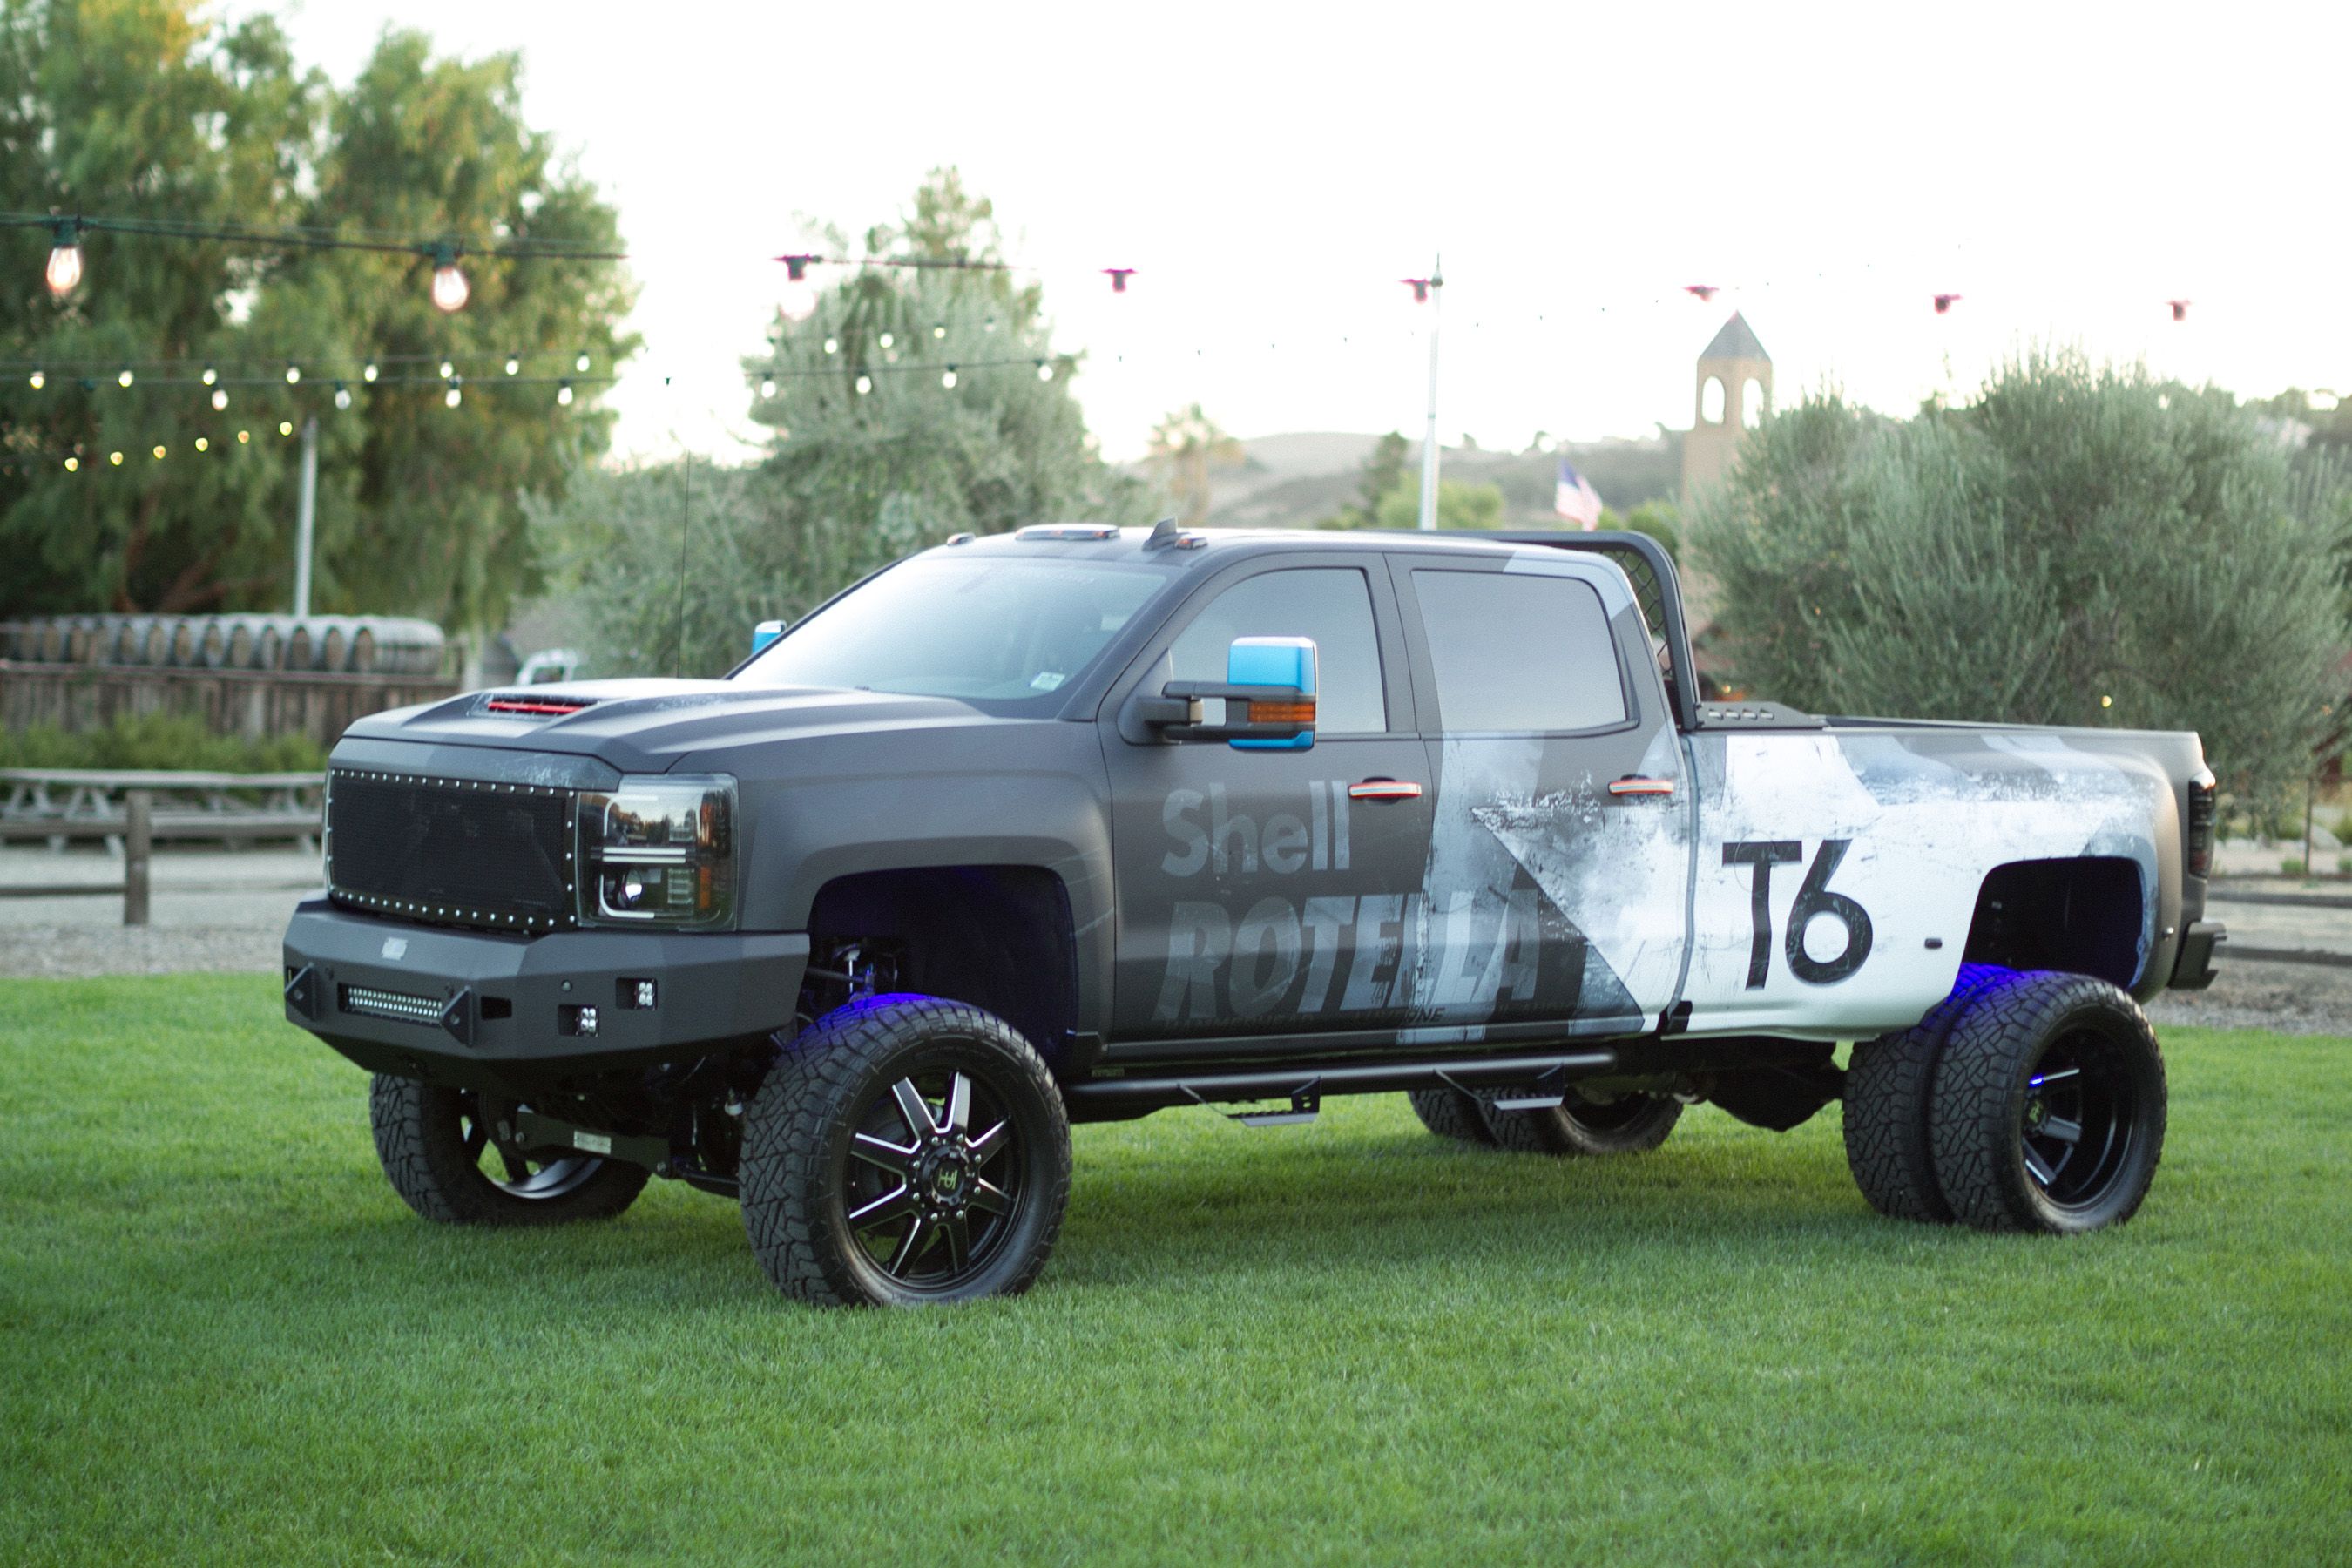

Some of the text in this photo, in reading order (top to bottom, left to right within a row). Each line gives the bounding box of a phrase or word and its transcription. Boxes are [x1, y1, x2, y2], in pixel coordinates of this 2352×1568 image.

[1162, 780, 1349, 877] Shell
[1152, 889, 1539, 1020] ROTELLA
[1722, 839, 1873, 990] T6
